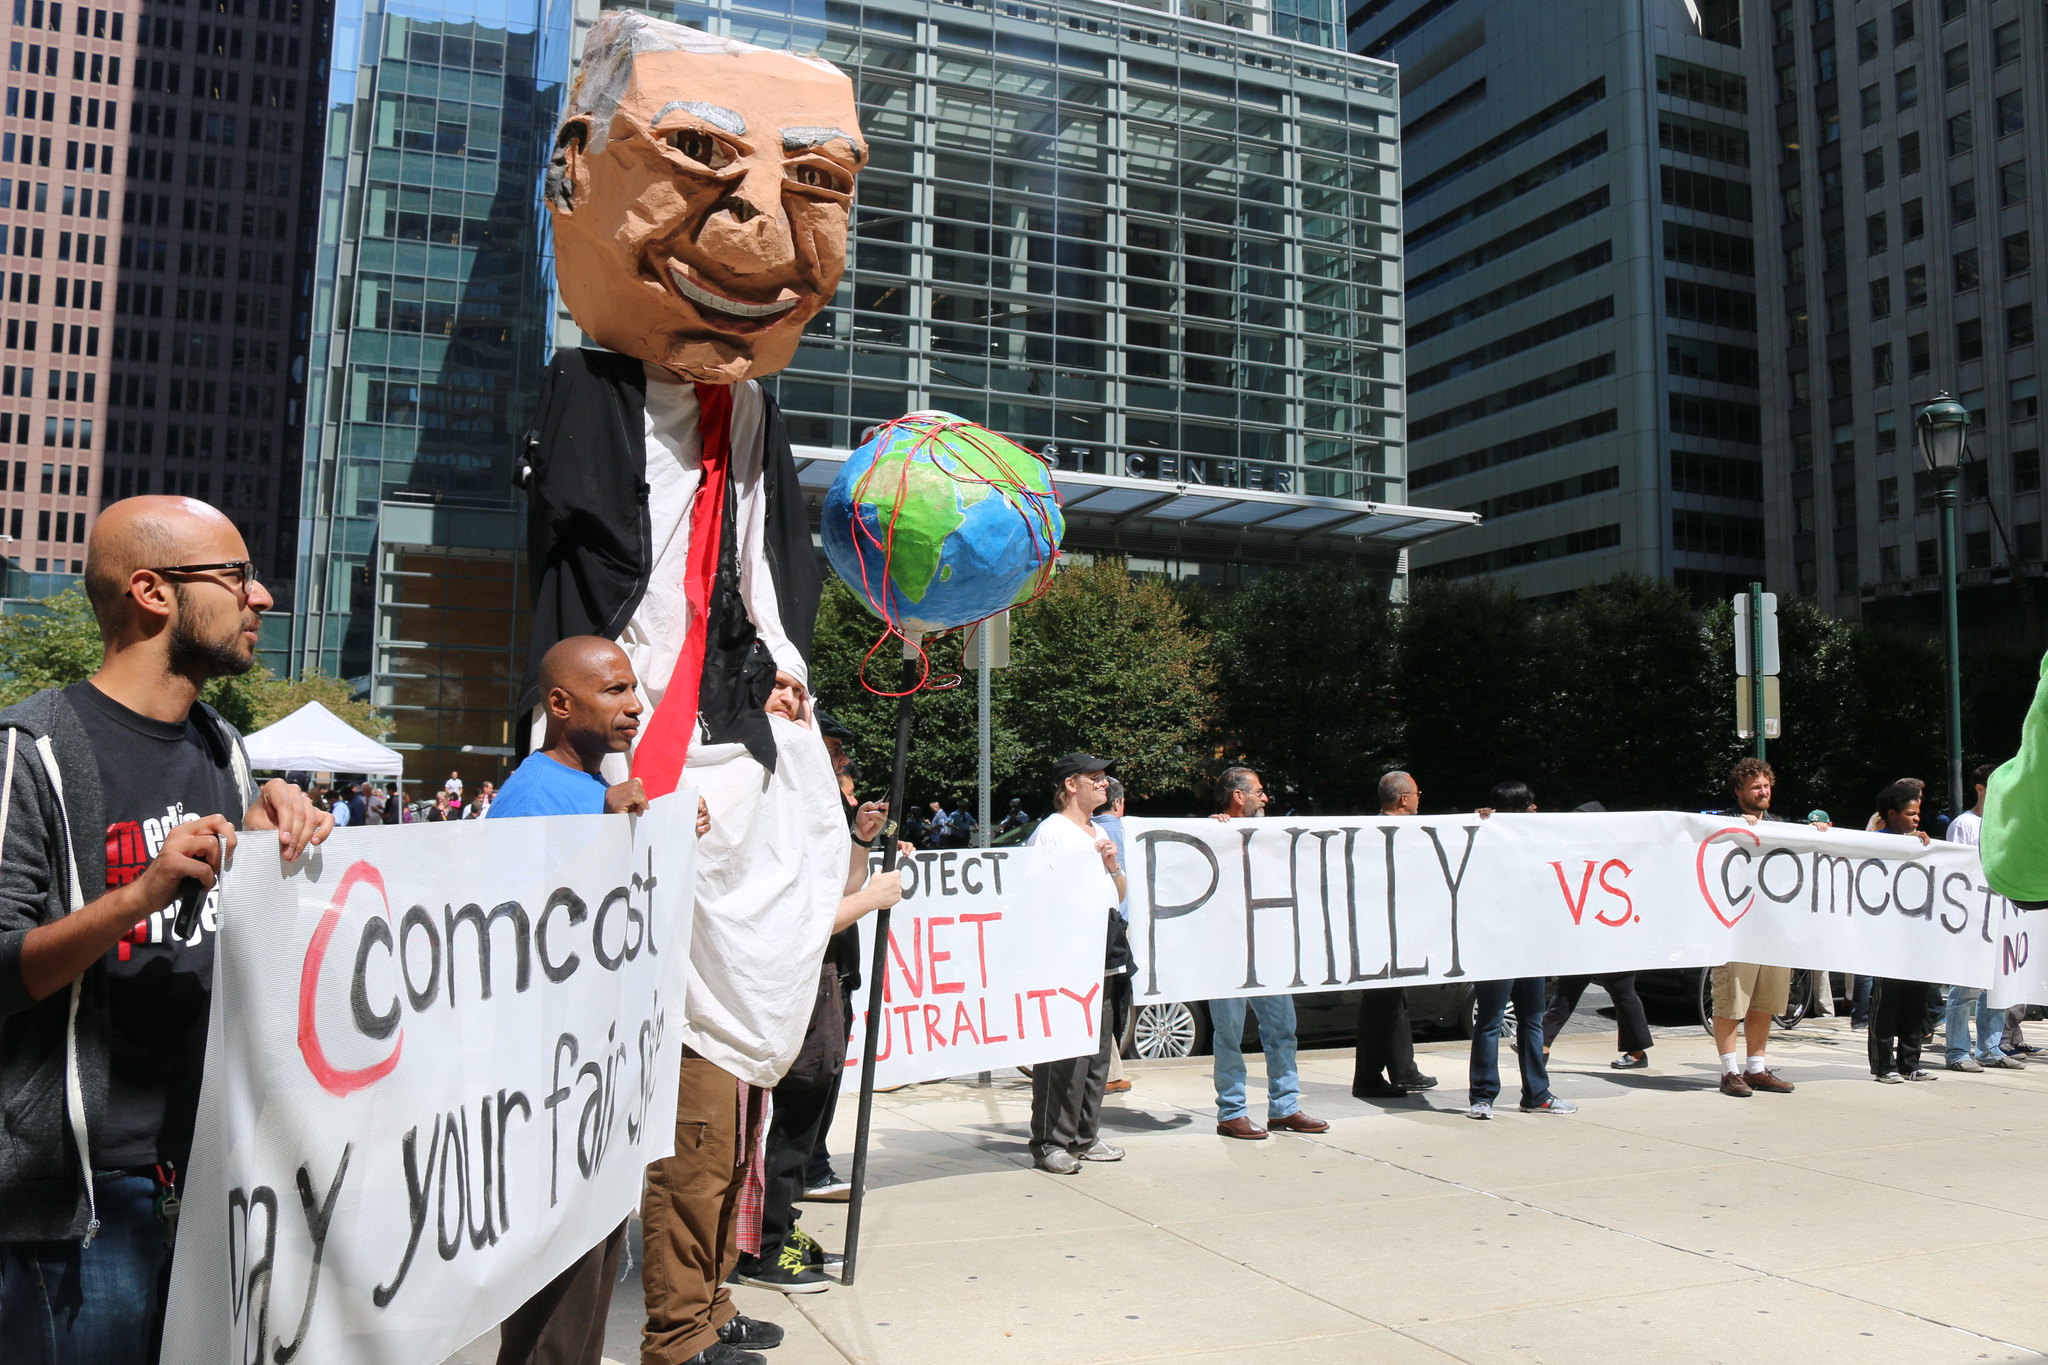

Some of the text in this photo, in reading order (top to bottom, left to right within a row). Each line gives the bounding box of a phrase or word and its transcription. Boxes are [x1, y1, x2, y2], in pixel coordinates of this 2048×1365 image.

[1125, 453, 1293, 494] CENTER
[869, 852, 1009, 900] OTECT
[1134, 825, 1479, 996] PHILLY
[1546, 858, 1641, 927] VS.
[882, 912, 1003, 1003] NET
[2002, 931, 2028, 976] NO
[844, 982, 1100, 1067] UTRALITY
[371, 1088, 532, 1308] your
[544, 1019, 627, 1208] fair
